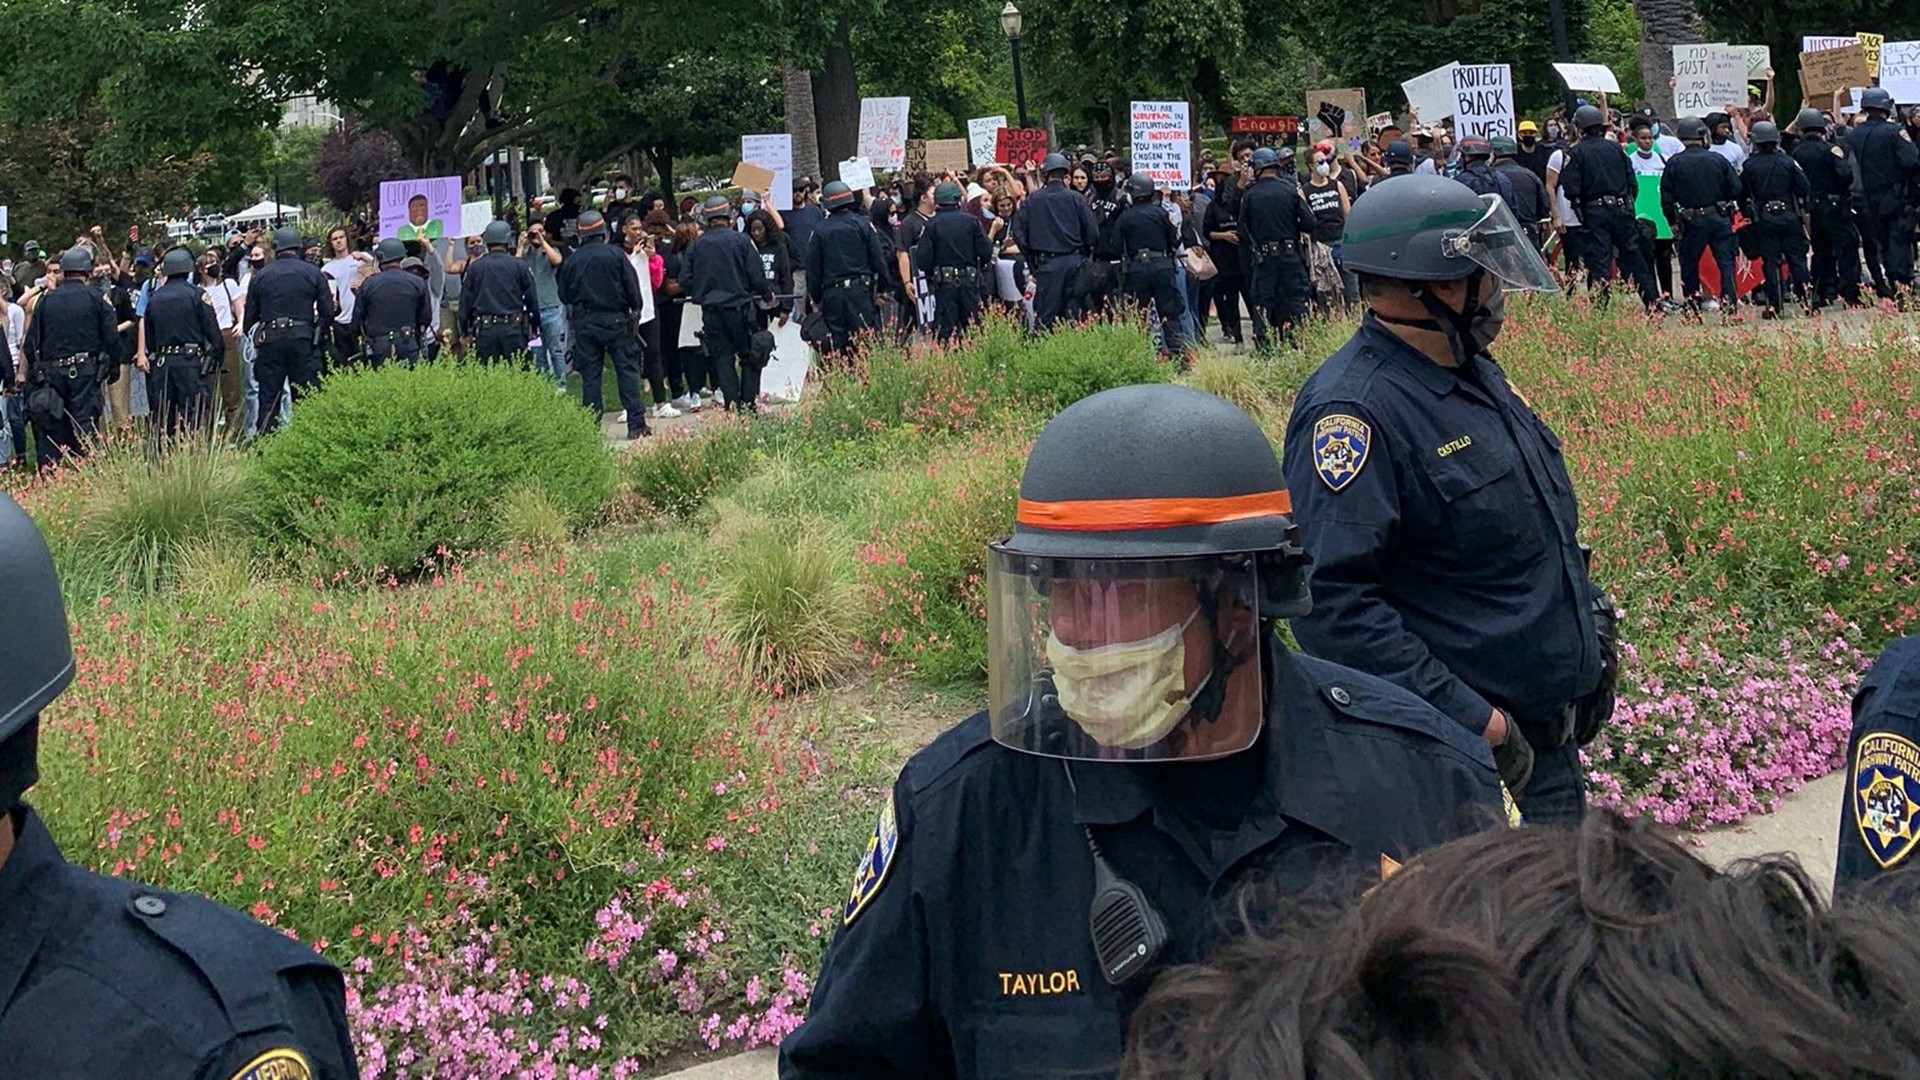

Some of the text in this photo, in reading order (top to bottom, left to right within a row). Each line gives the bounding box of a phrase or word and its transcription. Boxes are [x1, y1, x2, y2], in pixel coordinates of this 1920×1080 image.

[1864, 49, 1879, 61] VES
[1884, 43, 1920, 55] BLA
[1720, 52, 1743, 60] stand
[1884, 52, 1920, 65] LIV
[1882, 65, 1920, 77] MATT
[1452, 66, 1506, 89] PROTECT
[1711, 79, 1733, 88] Black
[1458, 89, 1507, 116] BLACK
[1678, 91, 1710, 108] PEAC
[1160, 104, 1173, 112] ARE
[1134, 121, 1182, 129] SITUATIONS
[1238, 117, 1297, 132] Enough
[1007, 129, 1042, 141] STOP
[1134, 131, 1187, 140] OF INJUSTICE
[1133, 142, 1173, 151] YOU HAVE
[906, 150, 926, 160] LIV
[1134, 152, 1163, 160] CHOSEN
[1312, 201, 1339, 211] charity
[1320, 417, 1365, 433] CALIFORNIA
[1437, 435, 1472, 458] CASTILLO
[1864, 738, 1920, 767] CALIFORNI
[1894, 756, 1920, 785] PATR
[999, 969, 1080, 995] TAYLOR
